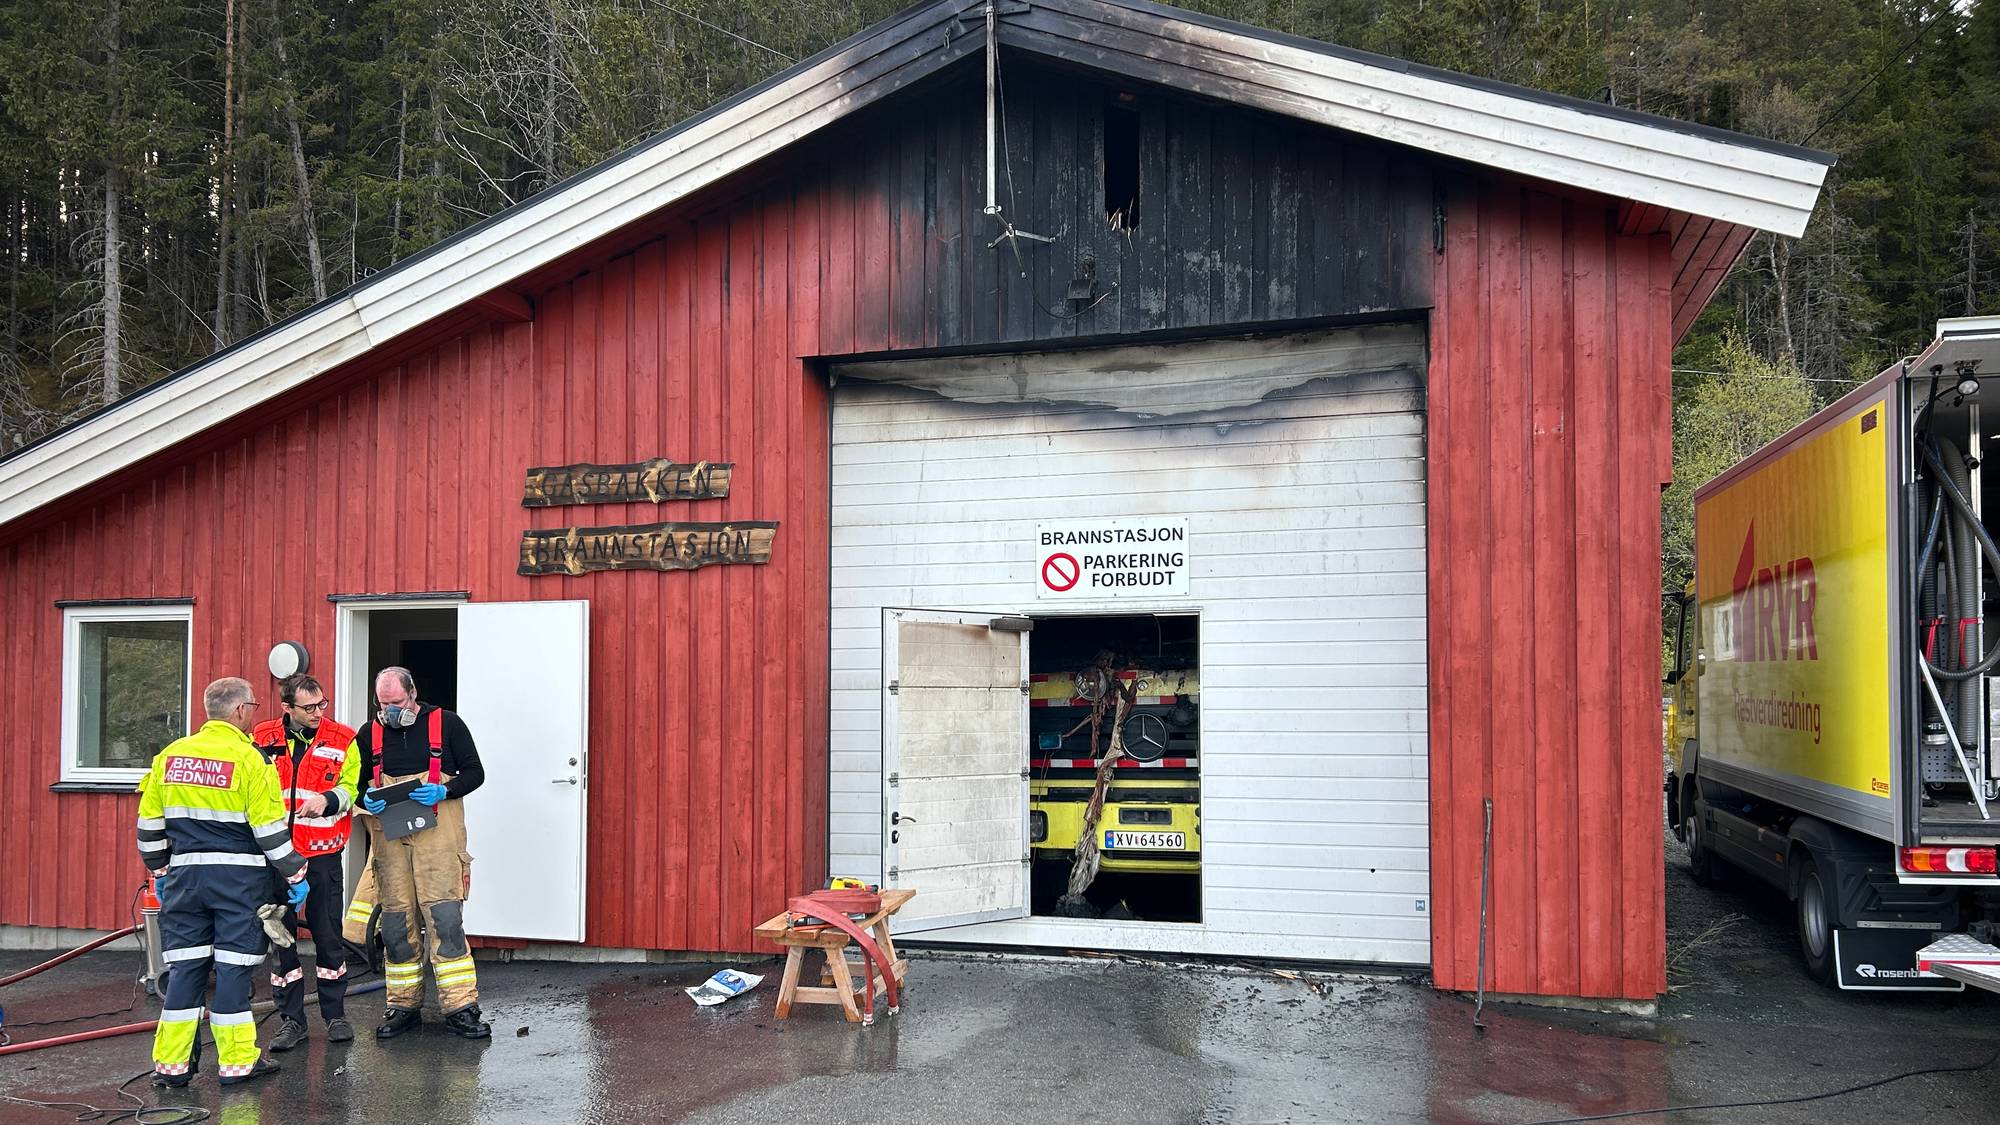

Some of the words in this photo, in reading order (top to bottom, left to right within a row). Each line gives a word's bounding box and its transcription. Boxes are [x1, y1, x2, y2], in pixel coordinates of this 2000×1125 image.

[1041, 527, 1184, 546] BRANNSTASJON
[535, 530, 751, 563] BRANNSTASJON
[1084, 552, 1184, 569] PARKERING
[1092, 571, 1176, 587] FORBUDT
[1758, 556, 1819, 661] RVR
[1734, 688, 1821, 744] Restverdiredning
[173, 757, 223, 773] BRANN
[1116, 833, 1134, 846] XV
[1140, 834, 1182, 847] 64560
[1877, 967, 1918, 978] rosenb
